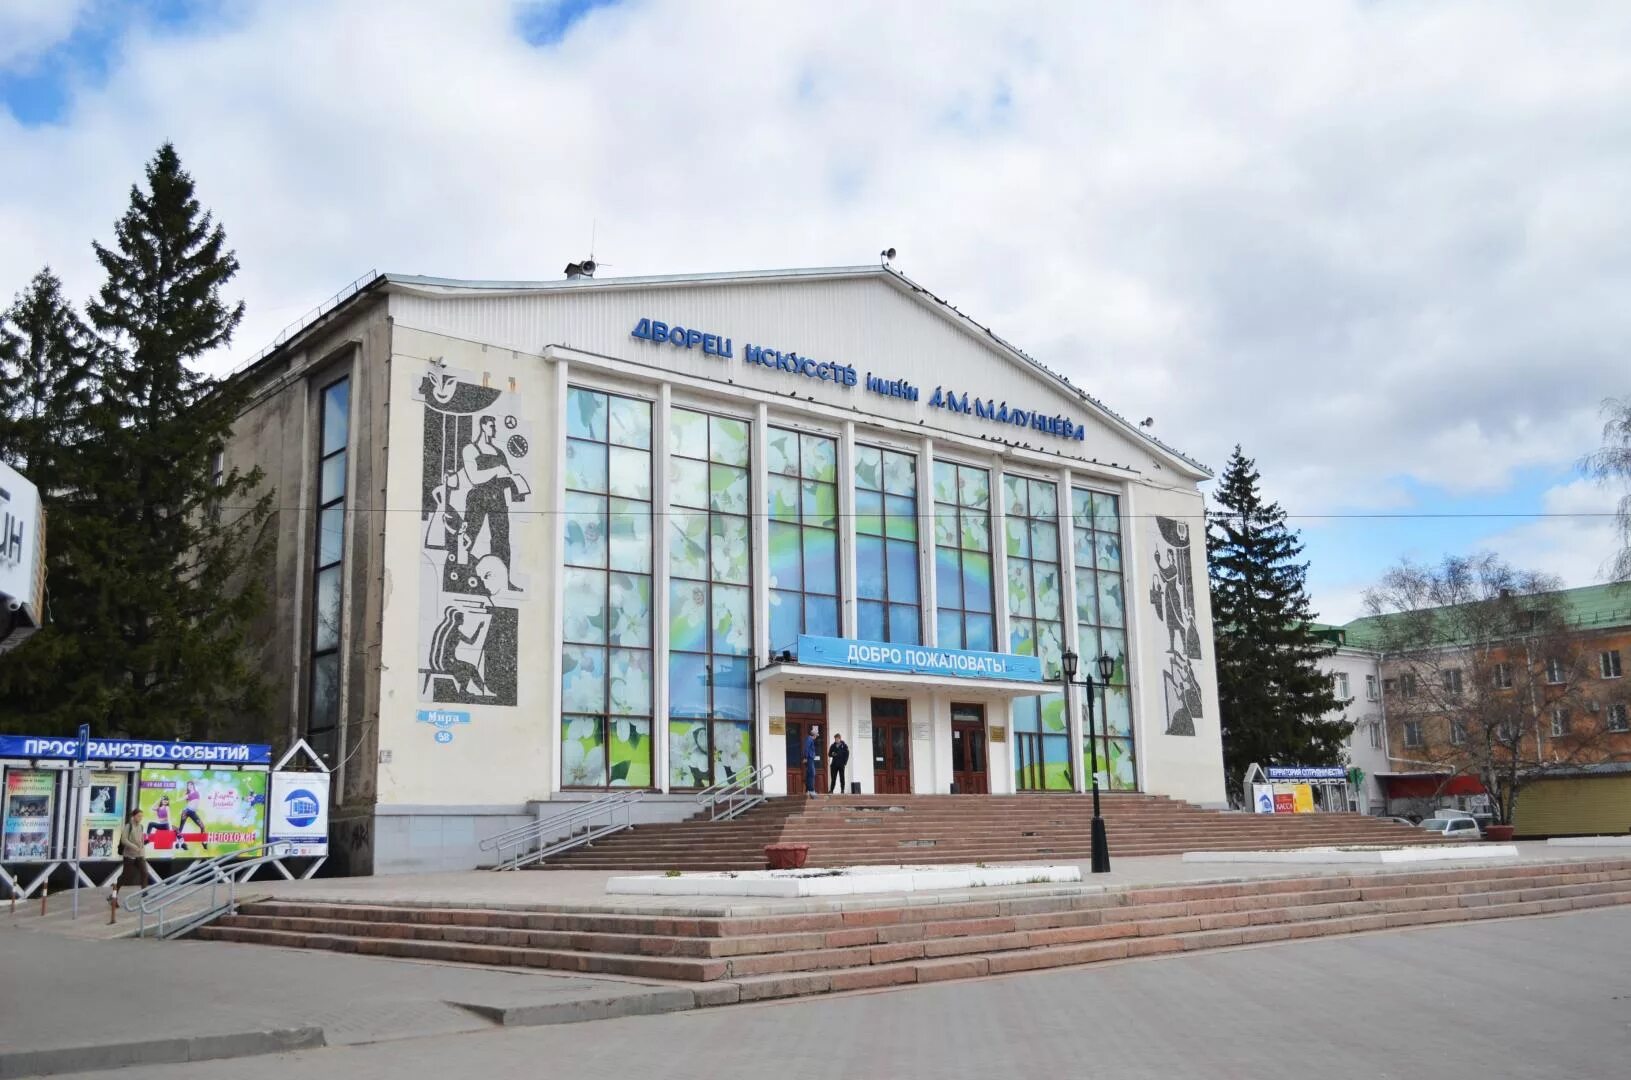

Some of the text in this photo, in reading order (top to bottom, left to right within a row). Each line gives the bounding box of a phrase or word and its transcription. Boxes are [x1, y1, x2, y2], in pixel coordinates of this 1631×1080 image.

[631, 317, 733, 359] ДВОРЕЦ
[745, 342, 857, 387] ИСКУССТВ
[866, 374, 919, 402] ИМЕНИ
[847, 644, 1006, 673] ДОБРО ПОЖАЛОВАТЬ!
[428, 711, 460, 724] Мира
[25, 739, 249, 761] ПРОСРАНСТВО СОБЫТИЙ
[207, 832, 256, 843] НЕПОХОЖИЕ
